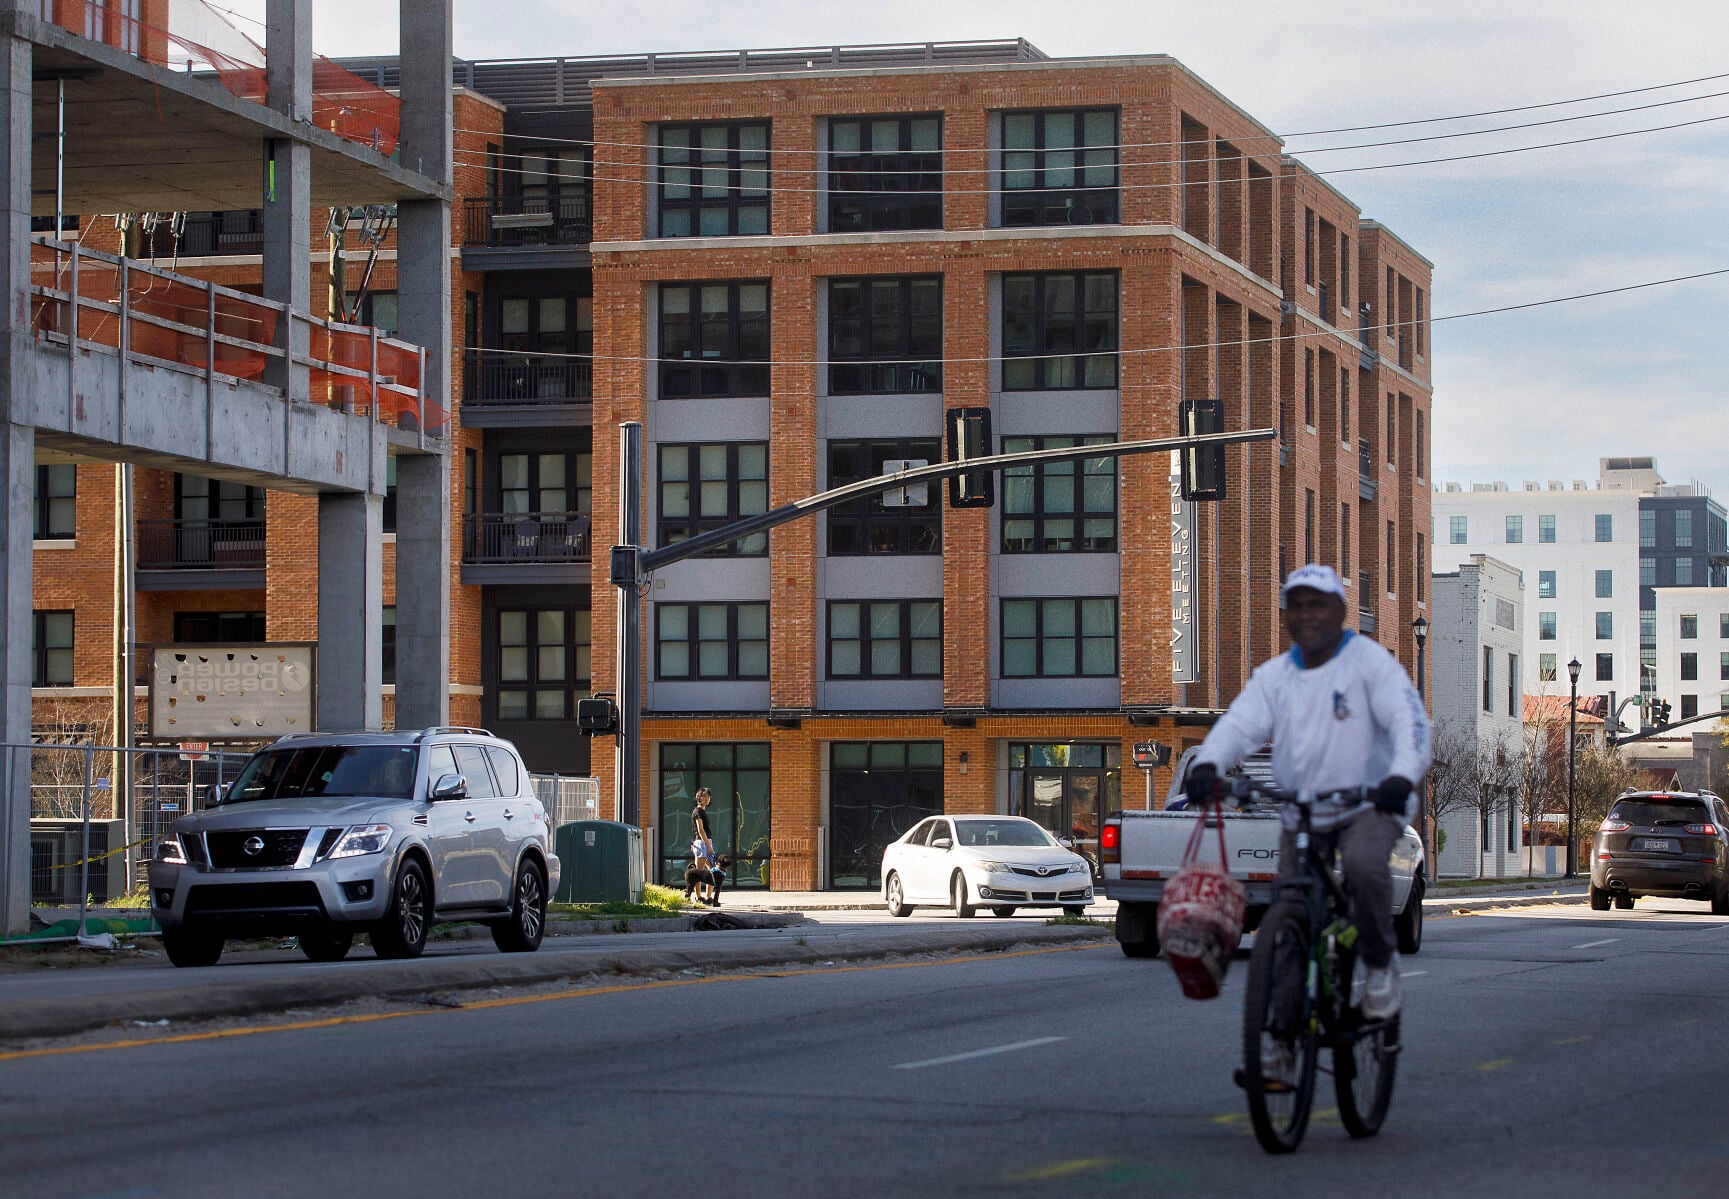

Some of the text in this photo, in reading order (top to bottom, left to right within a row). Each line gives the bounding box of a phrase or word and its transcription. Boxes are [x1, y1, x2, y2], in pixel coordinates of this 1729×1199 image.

[1171, 483, 1184, 672] FIVE ELEVEN
[1182, 529, 1191, 624] MEETING
[186, 742, 203, 750] ENTER
[1237, 849, 1281, 859] FOR
